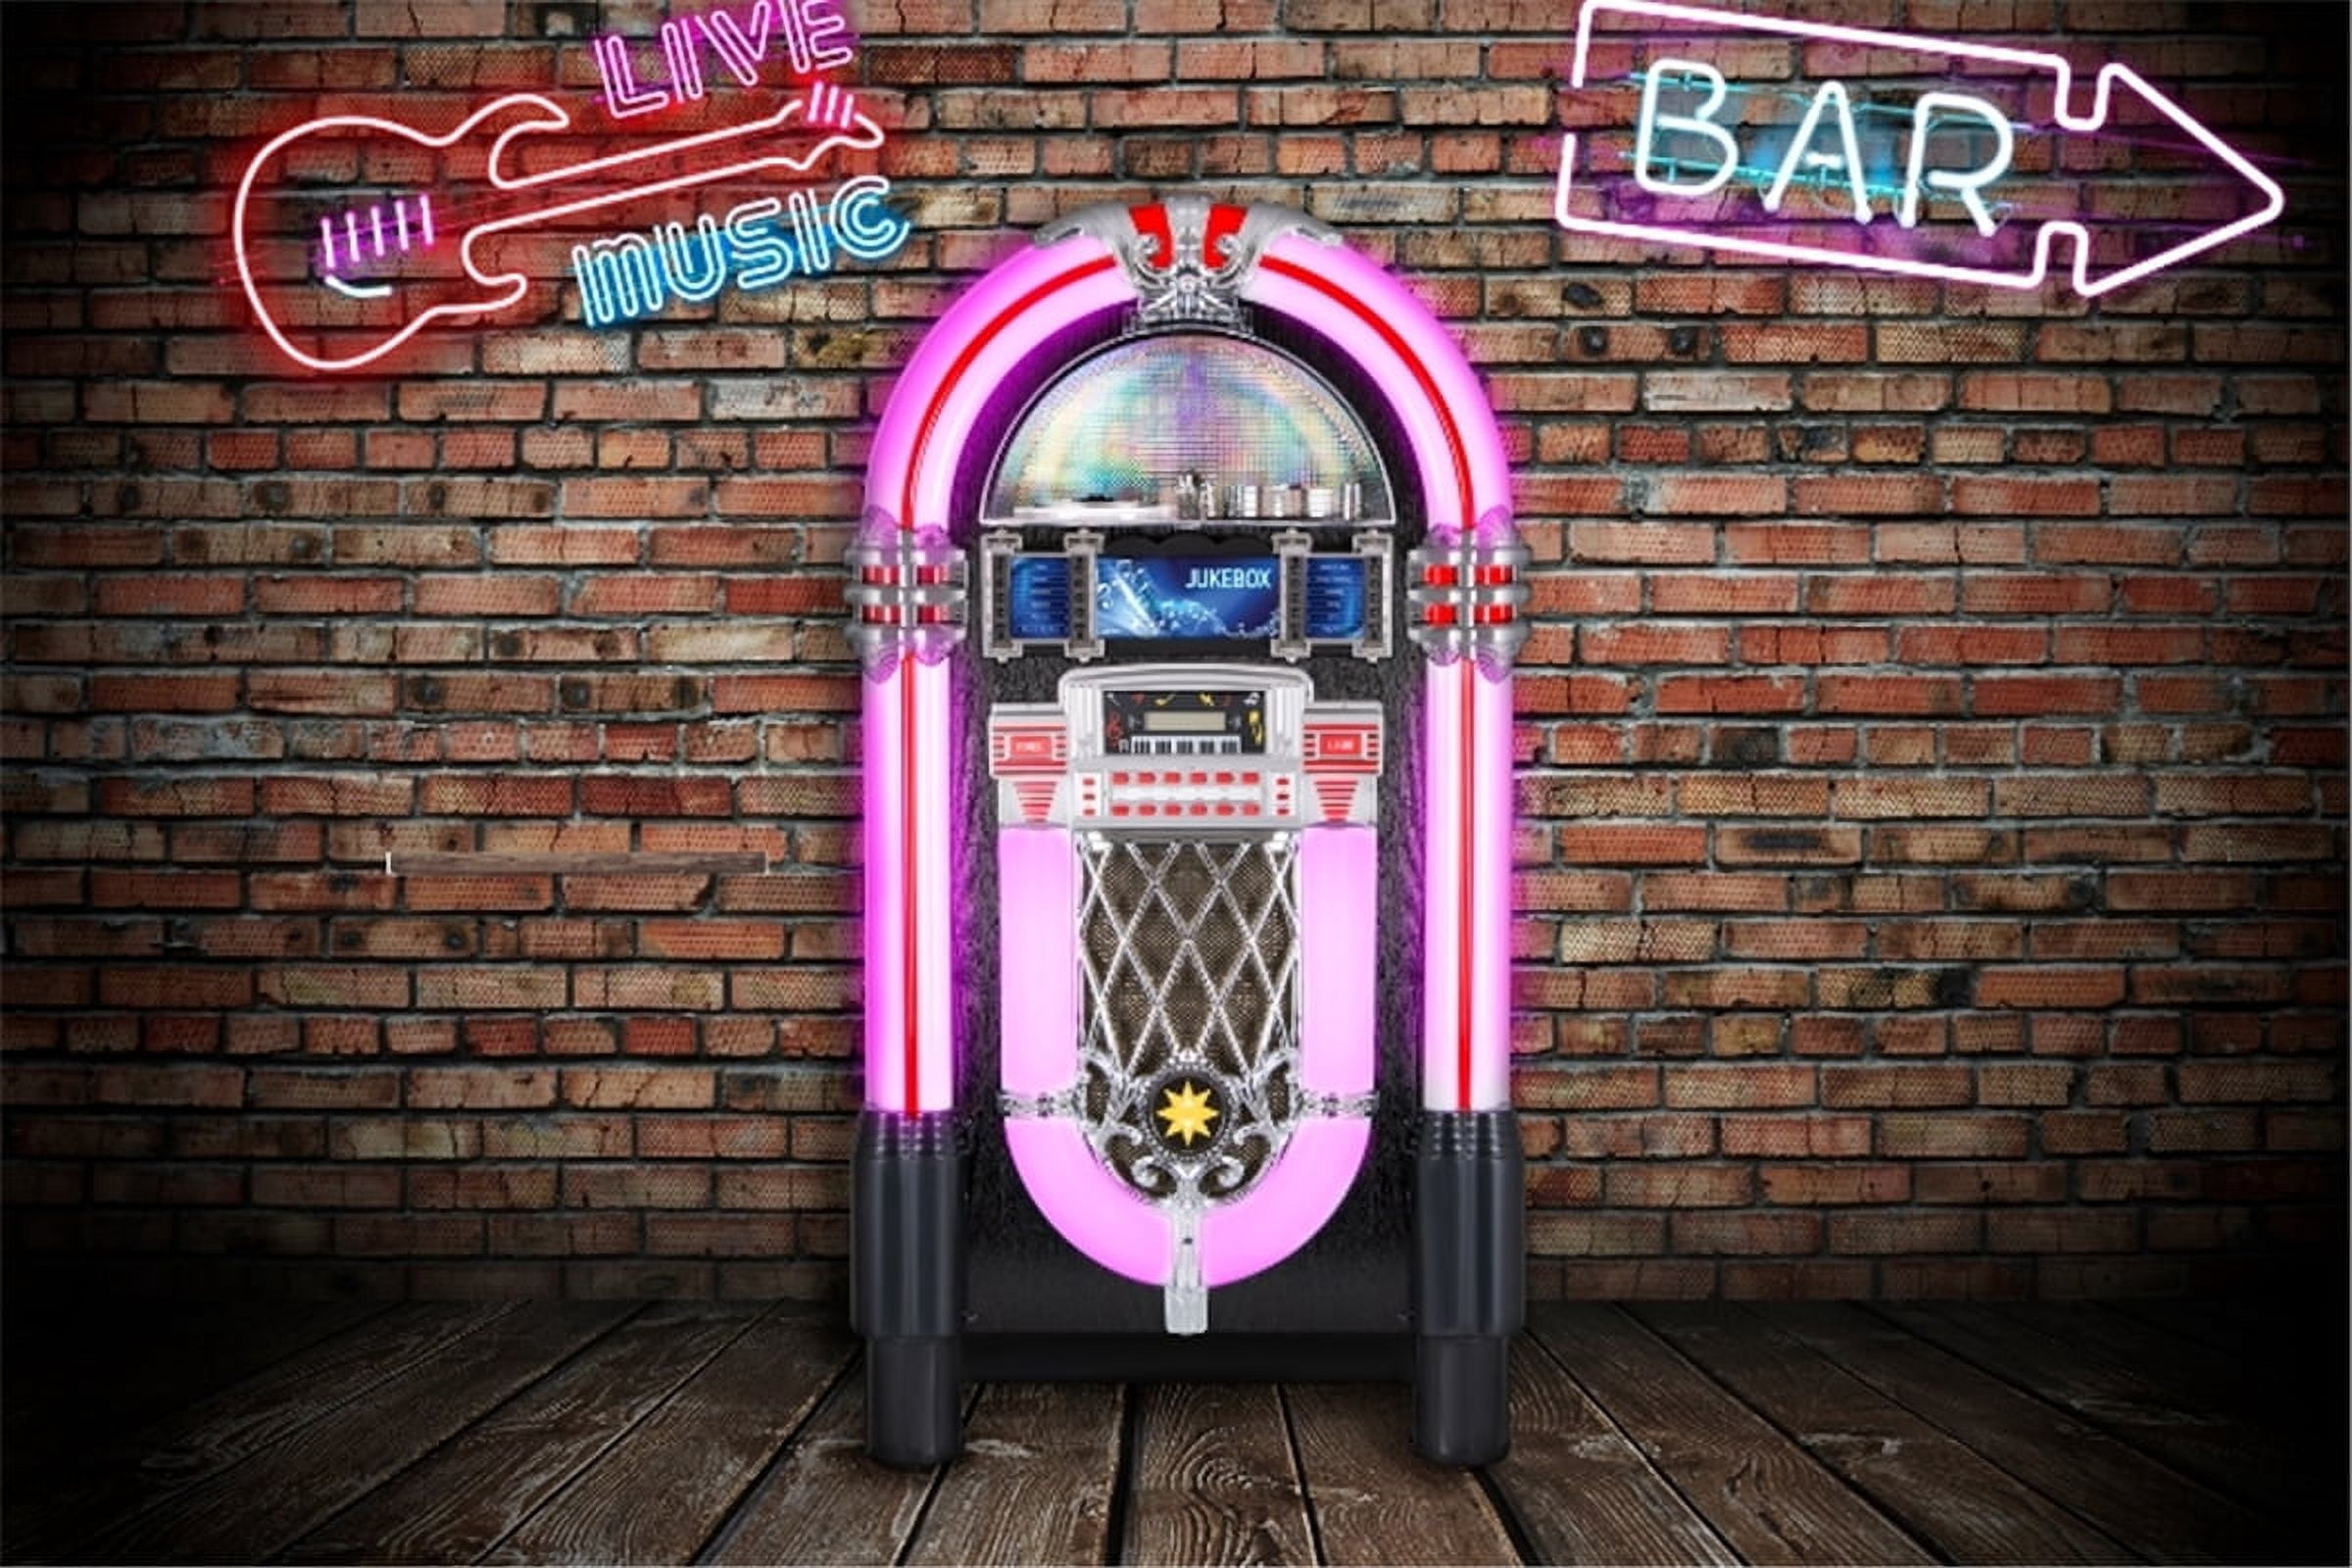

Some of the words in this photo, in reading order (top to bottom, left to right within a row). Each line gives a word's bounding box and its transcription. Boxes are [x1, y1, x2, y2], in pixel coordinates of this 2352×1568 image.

[594, 0, 854, 119] LIVE
[1633, 58, 2014, 236] BAR
[571, 174, 910, 326] MUSIC
[1184, 566, 1272, 589] JUKEBOX
